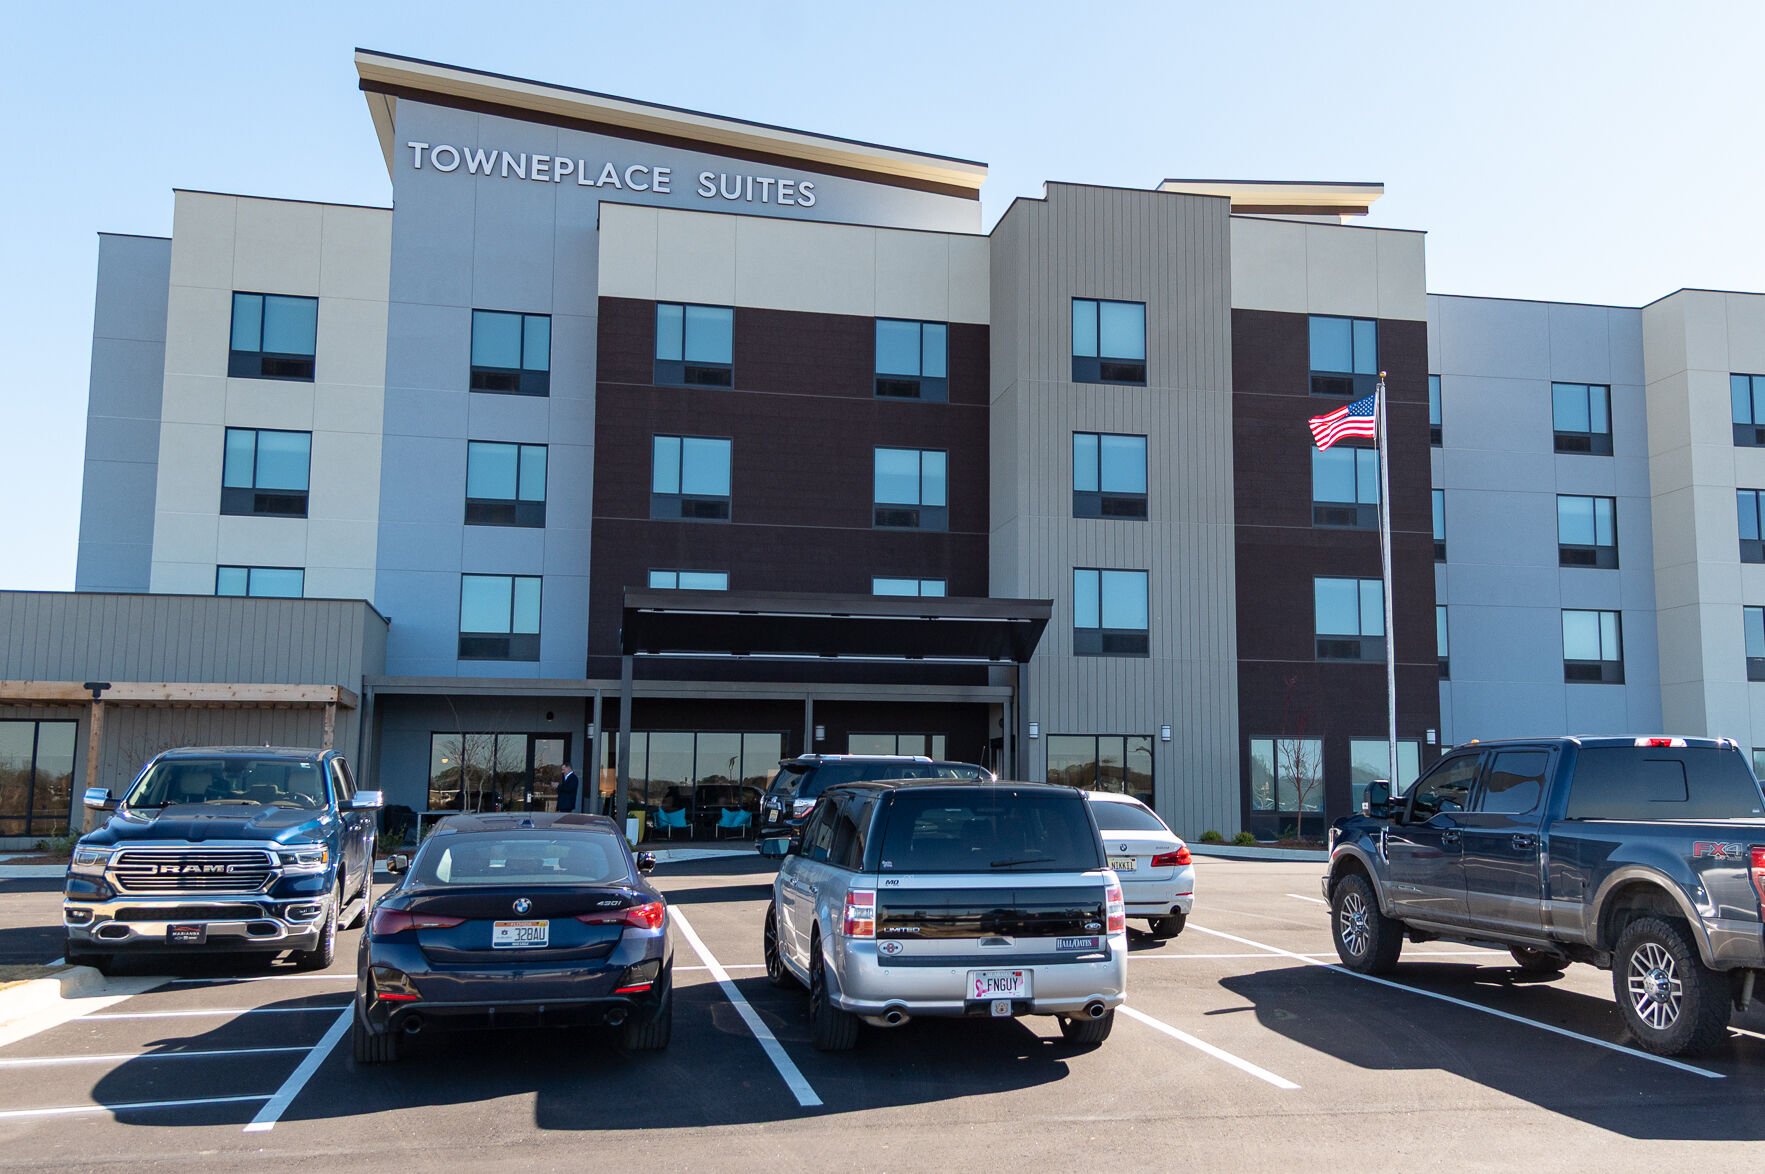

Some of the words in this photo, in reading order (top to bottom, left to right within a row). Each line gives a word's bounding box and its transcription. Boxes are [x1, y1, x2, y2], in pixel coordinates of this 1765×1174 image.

[408, 141, 672, 194] TOWNEPLACE
[697, 171, 817, 208] SUITES
[1693, 841, 1743, 859] FX4
[160, 864, 225, 873] RAM
[514, 927, 546, 941] 328AU
[987, 977, 1018, 992] FNGUY
